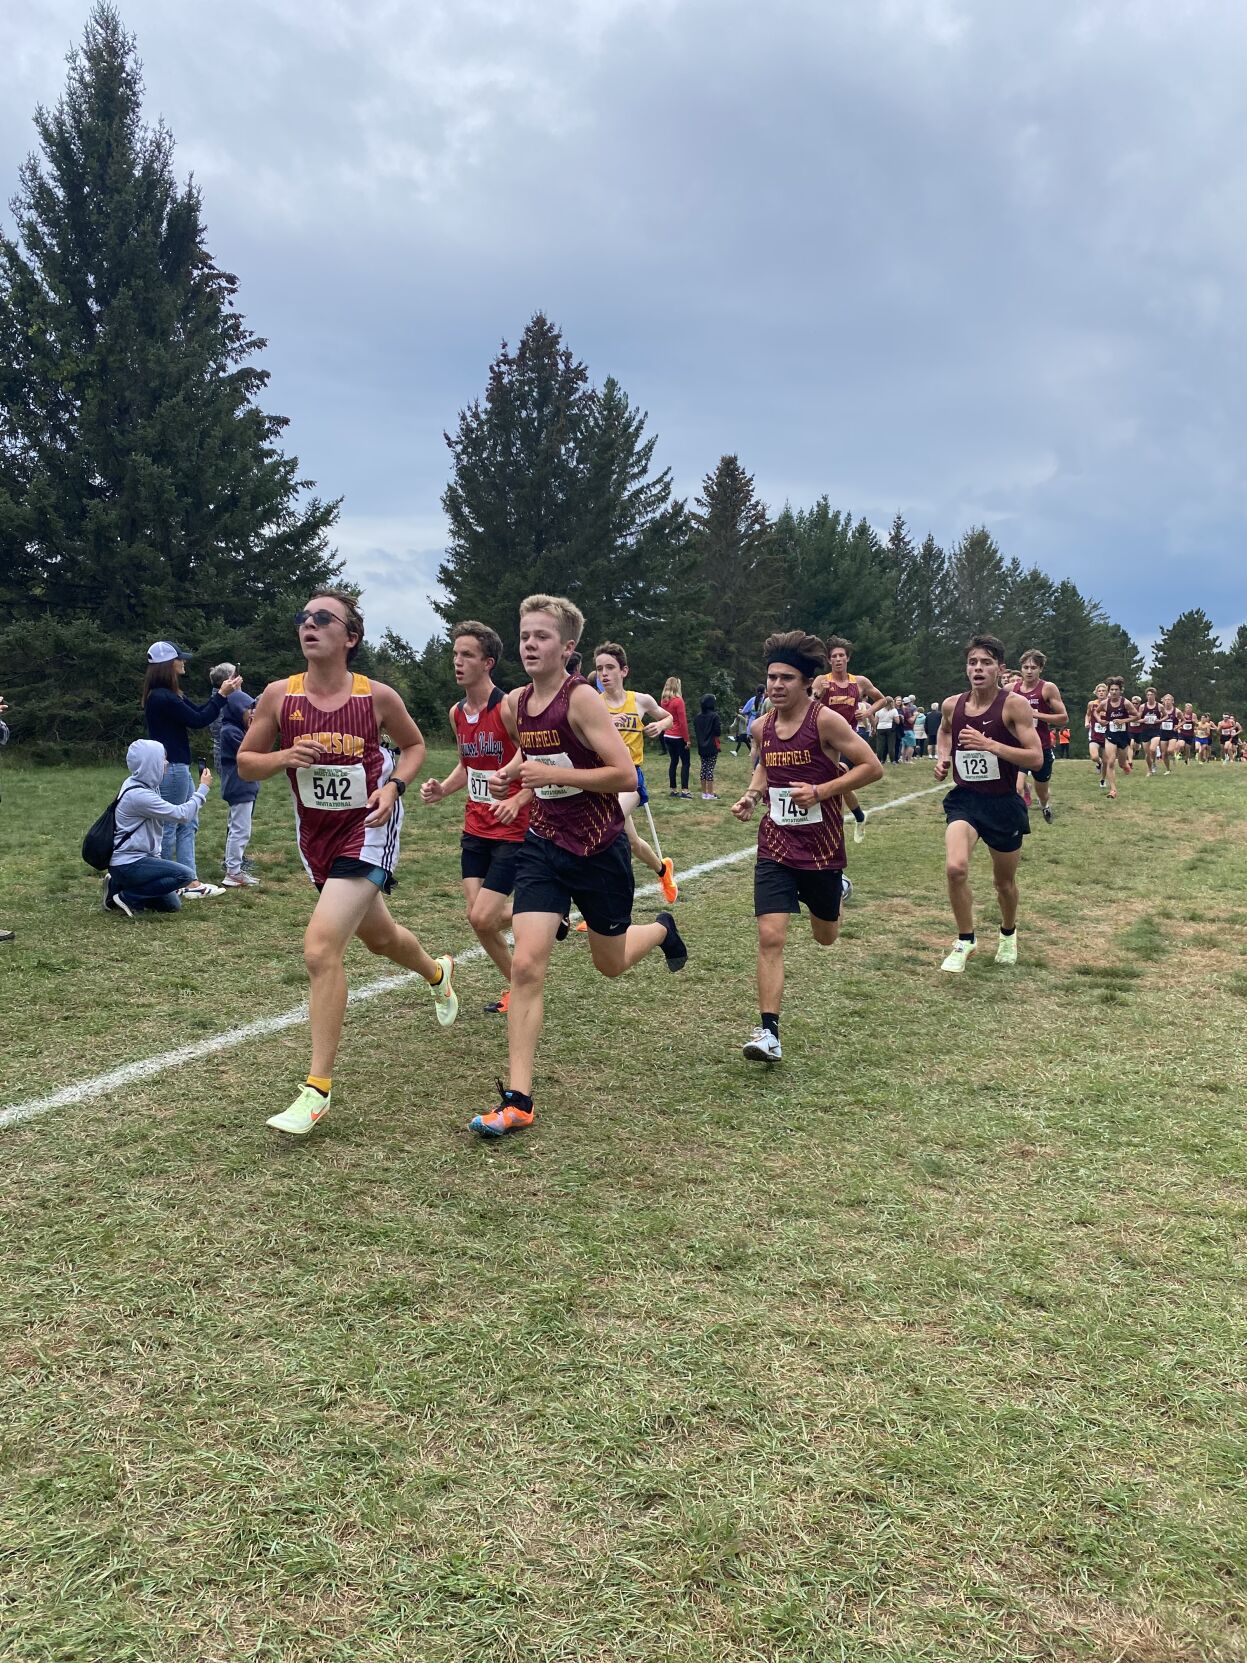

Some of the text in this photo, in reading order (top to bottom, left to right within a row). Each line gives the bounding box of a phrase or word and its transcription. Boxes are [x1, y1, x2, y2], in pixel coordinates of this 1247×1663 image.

[479, 730, 504, 765] Valley
[765, 749, 812, 767] NORTHFIELD
[962, 758, 988, 775] 123
[312, 776, 352, 801] 542
[471, 778, 488, 796] 877
[315, 800, 352, 808] INVITATIONAL
